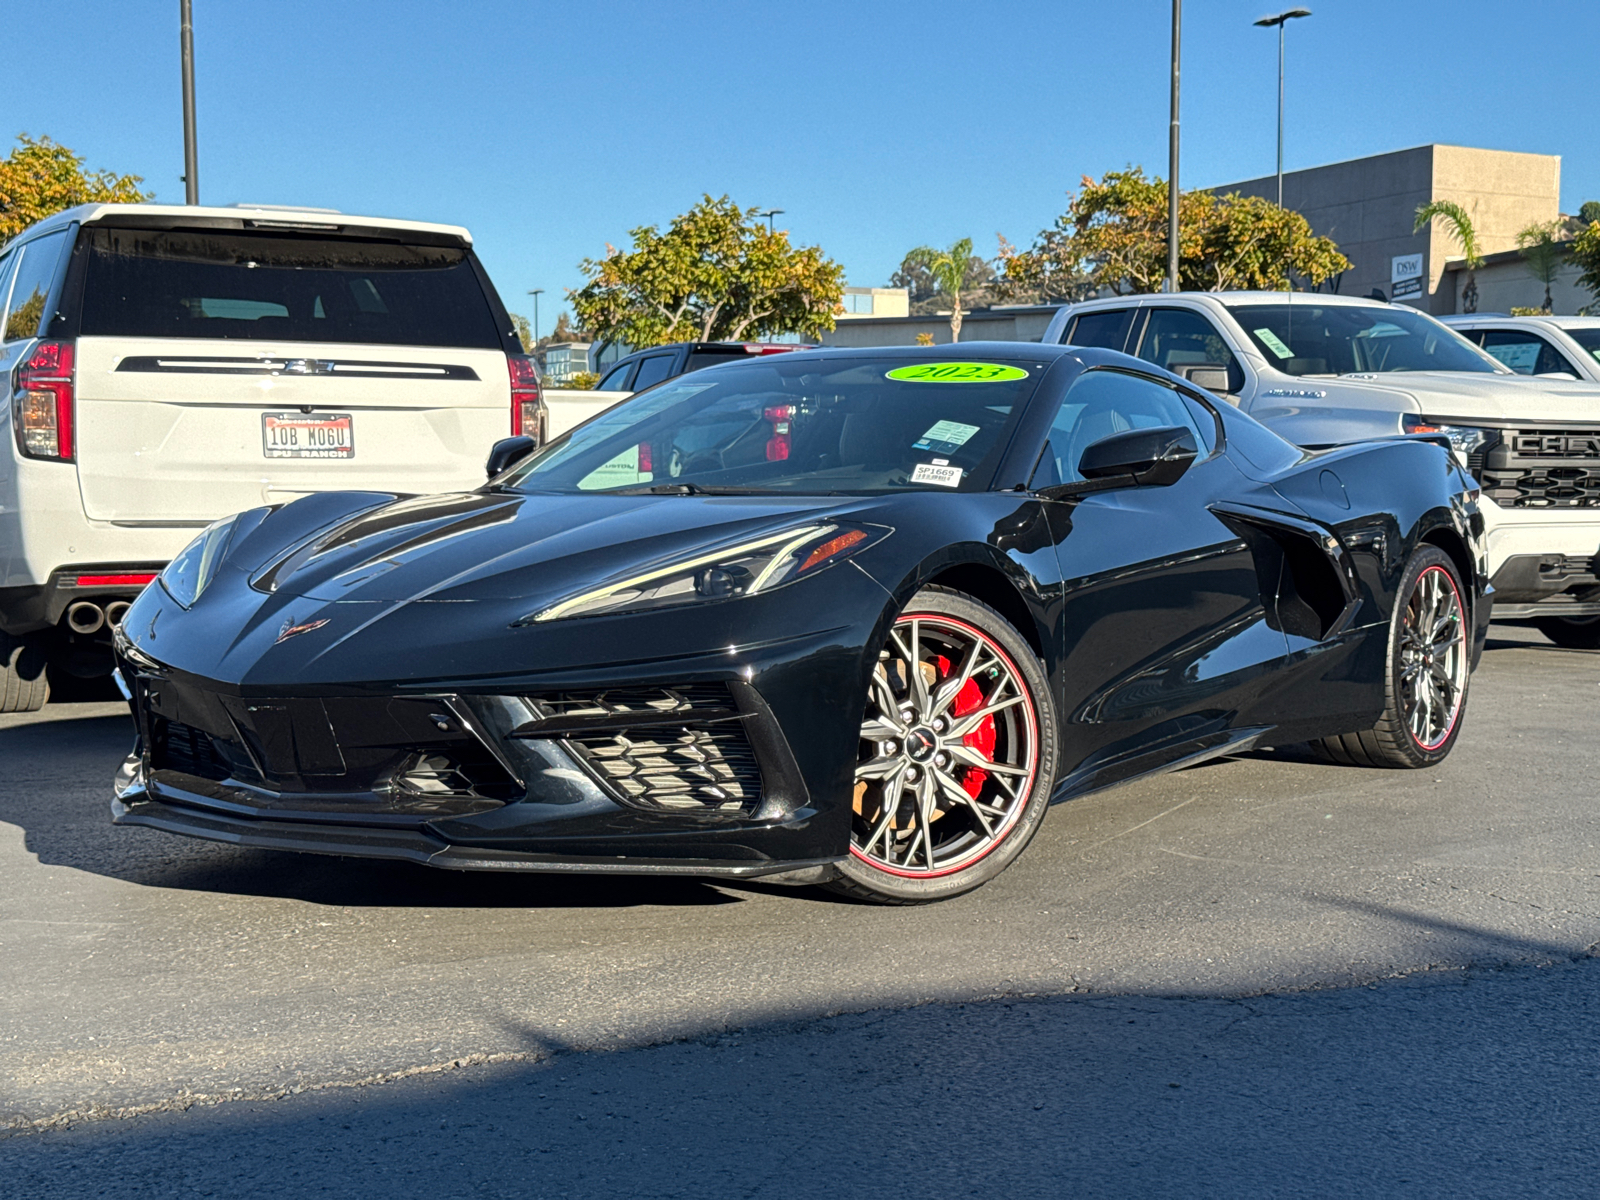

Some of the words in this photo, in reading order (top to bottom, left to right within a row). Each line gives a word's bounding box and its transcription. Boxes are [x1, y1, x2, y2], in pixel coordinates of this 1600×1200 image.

[1397, 260, 1418, 273] DSW
[906, 366, 1007, 379] 2023
[301, 450, 348, 458] RANCH
[917, 467, 955, 477] SP1669
[1041, 701, 1053, 772] MICHELIN
